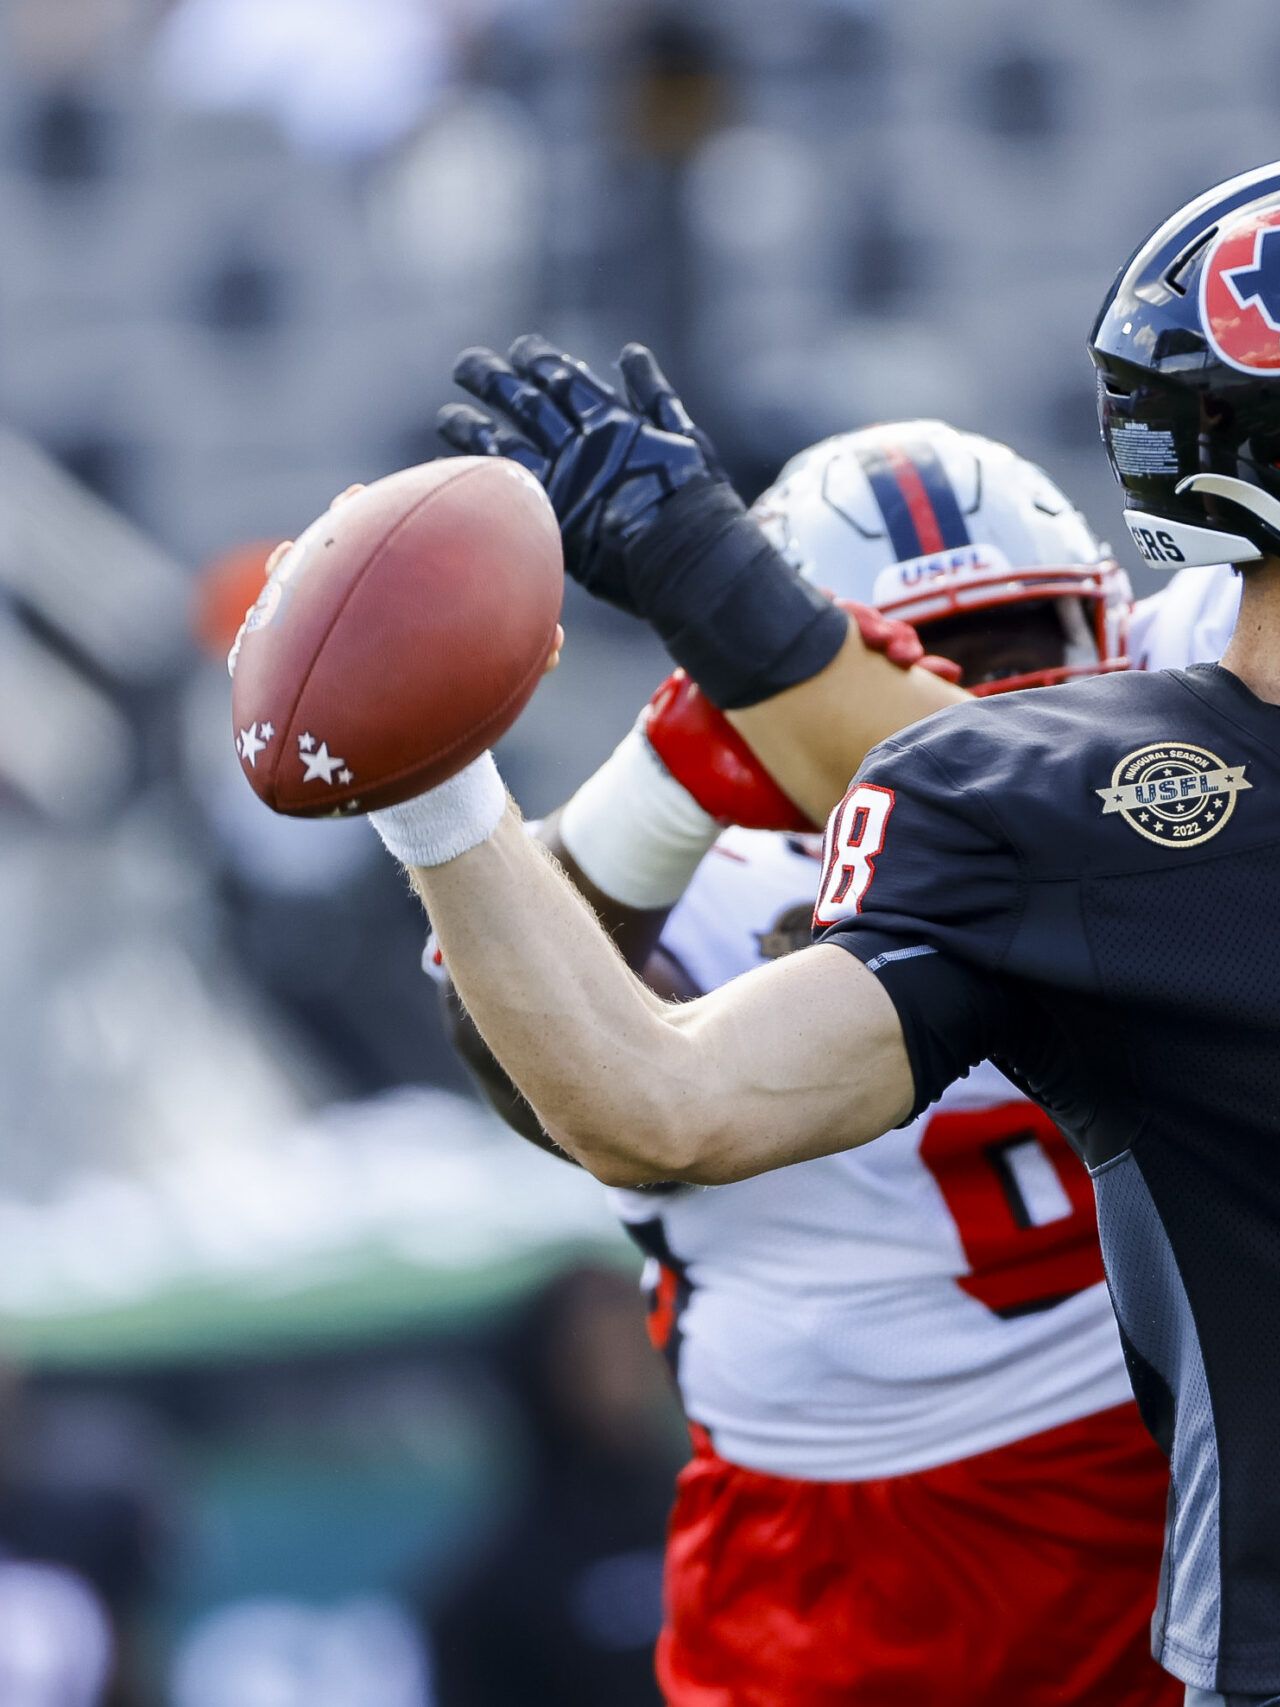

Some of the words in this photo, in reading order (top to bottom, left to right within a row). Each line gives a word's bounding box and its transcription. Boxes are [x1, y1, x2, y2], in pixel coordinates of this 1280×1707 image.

[900, 552, 990, 587] USFL
[1124, 751, 1169, 780] INAUGURAL
[1169, 749, 1210, 769] SEASON
[1134, 774, 1219, 805] USFL
[1172, 821, 1202, 837] 2022
